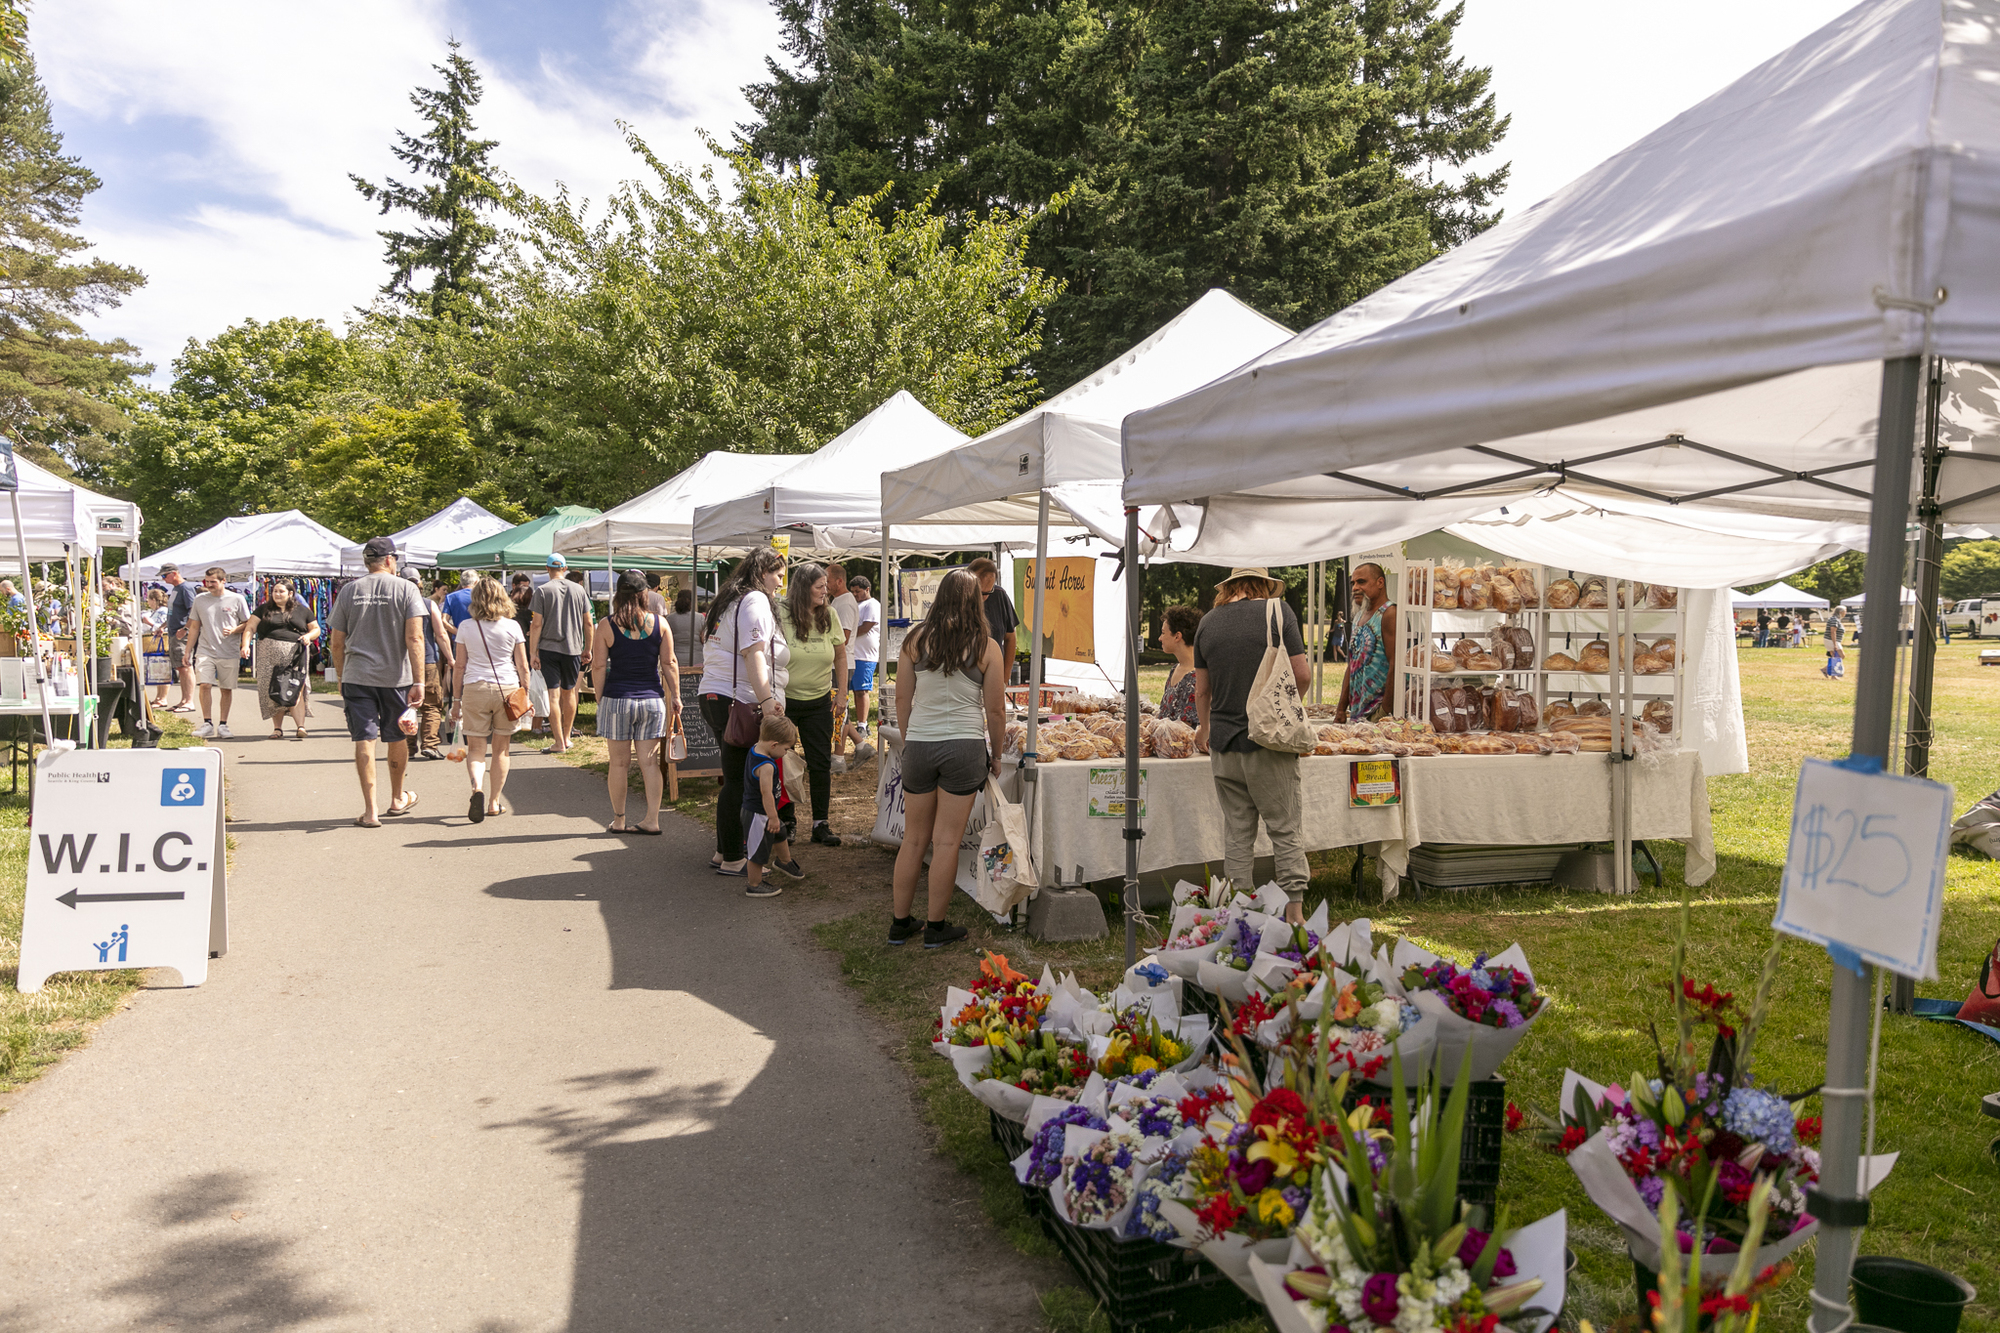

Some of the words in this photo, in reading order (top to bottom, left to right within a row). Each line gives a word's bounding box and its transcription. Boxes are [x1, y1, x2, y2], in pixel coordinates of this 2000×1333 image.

[1060, 565, 1086, 590] Acres
[1273, 670, 1291, 727] SAVANNAH
[1365, 772, 1388, 781] Bread
[38, 831, 208, 874] W.I.C.
[1801, 803, 1912, 898] $25
